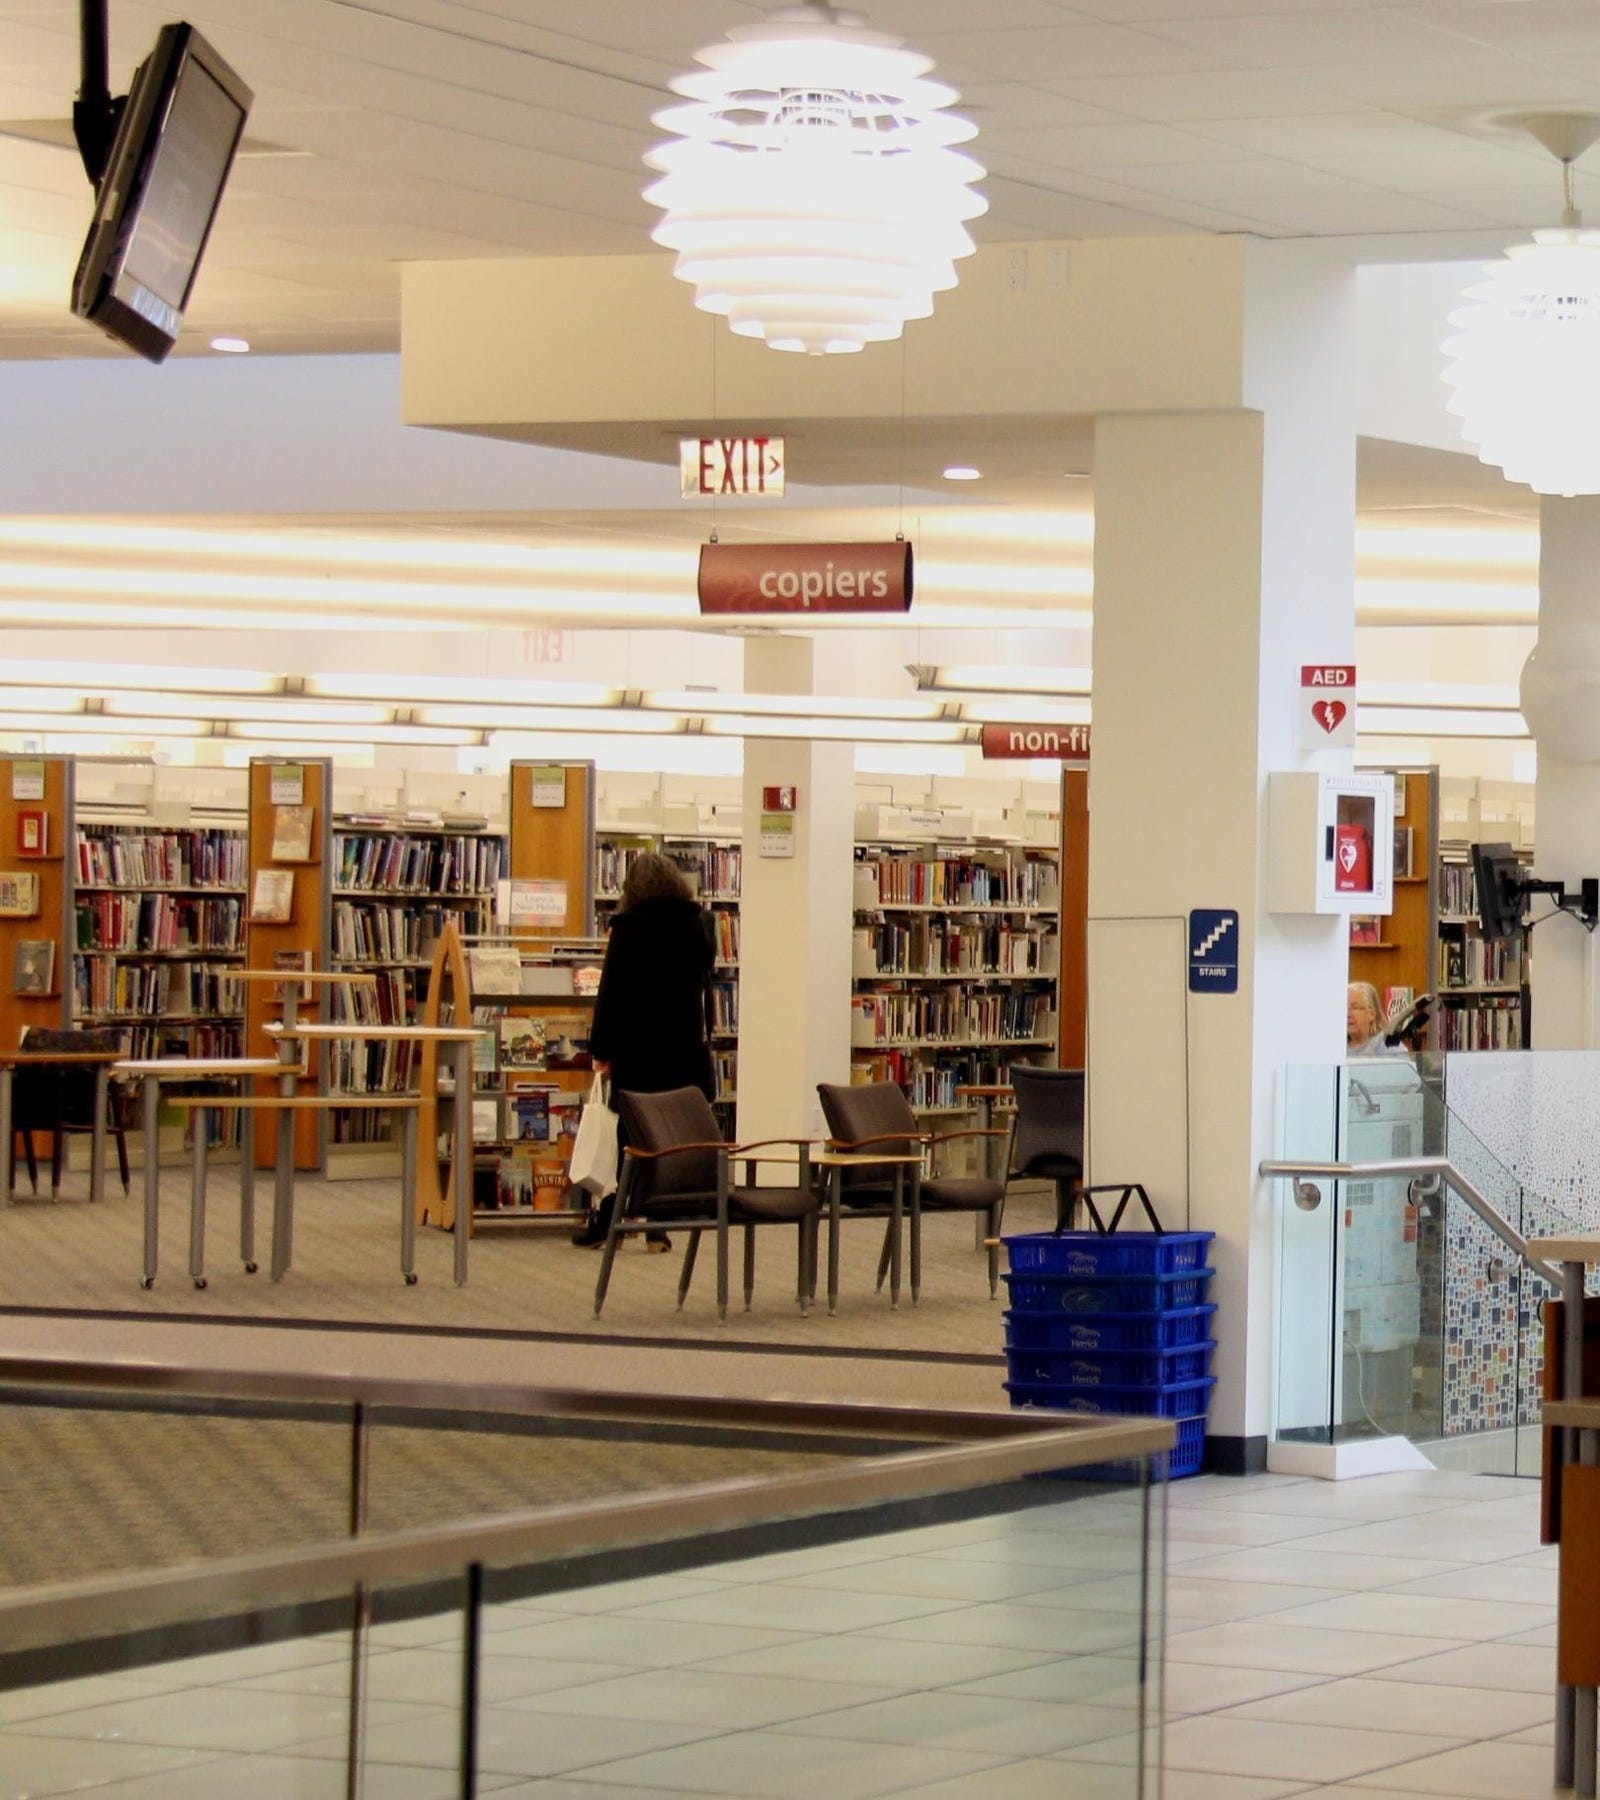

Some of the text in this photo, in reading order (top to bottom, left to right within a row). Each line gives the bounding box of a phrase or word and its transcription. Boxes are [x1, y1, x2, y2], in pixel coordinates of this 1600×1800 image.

[700, 438, 769, 494] EXIT
[759, 561, 888, 607] copiers
[1312, 669, 1348, 685] AED
[1009, 727, 1090, 752] non-fi
[1199, 968, 1227, 976] STAIRS
[1068, 1264, 1096, 1274] Herrick
